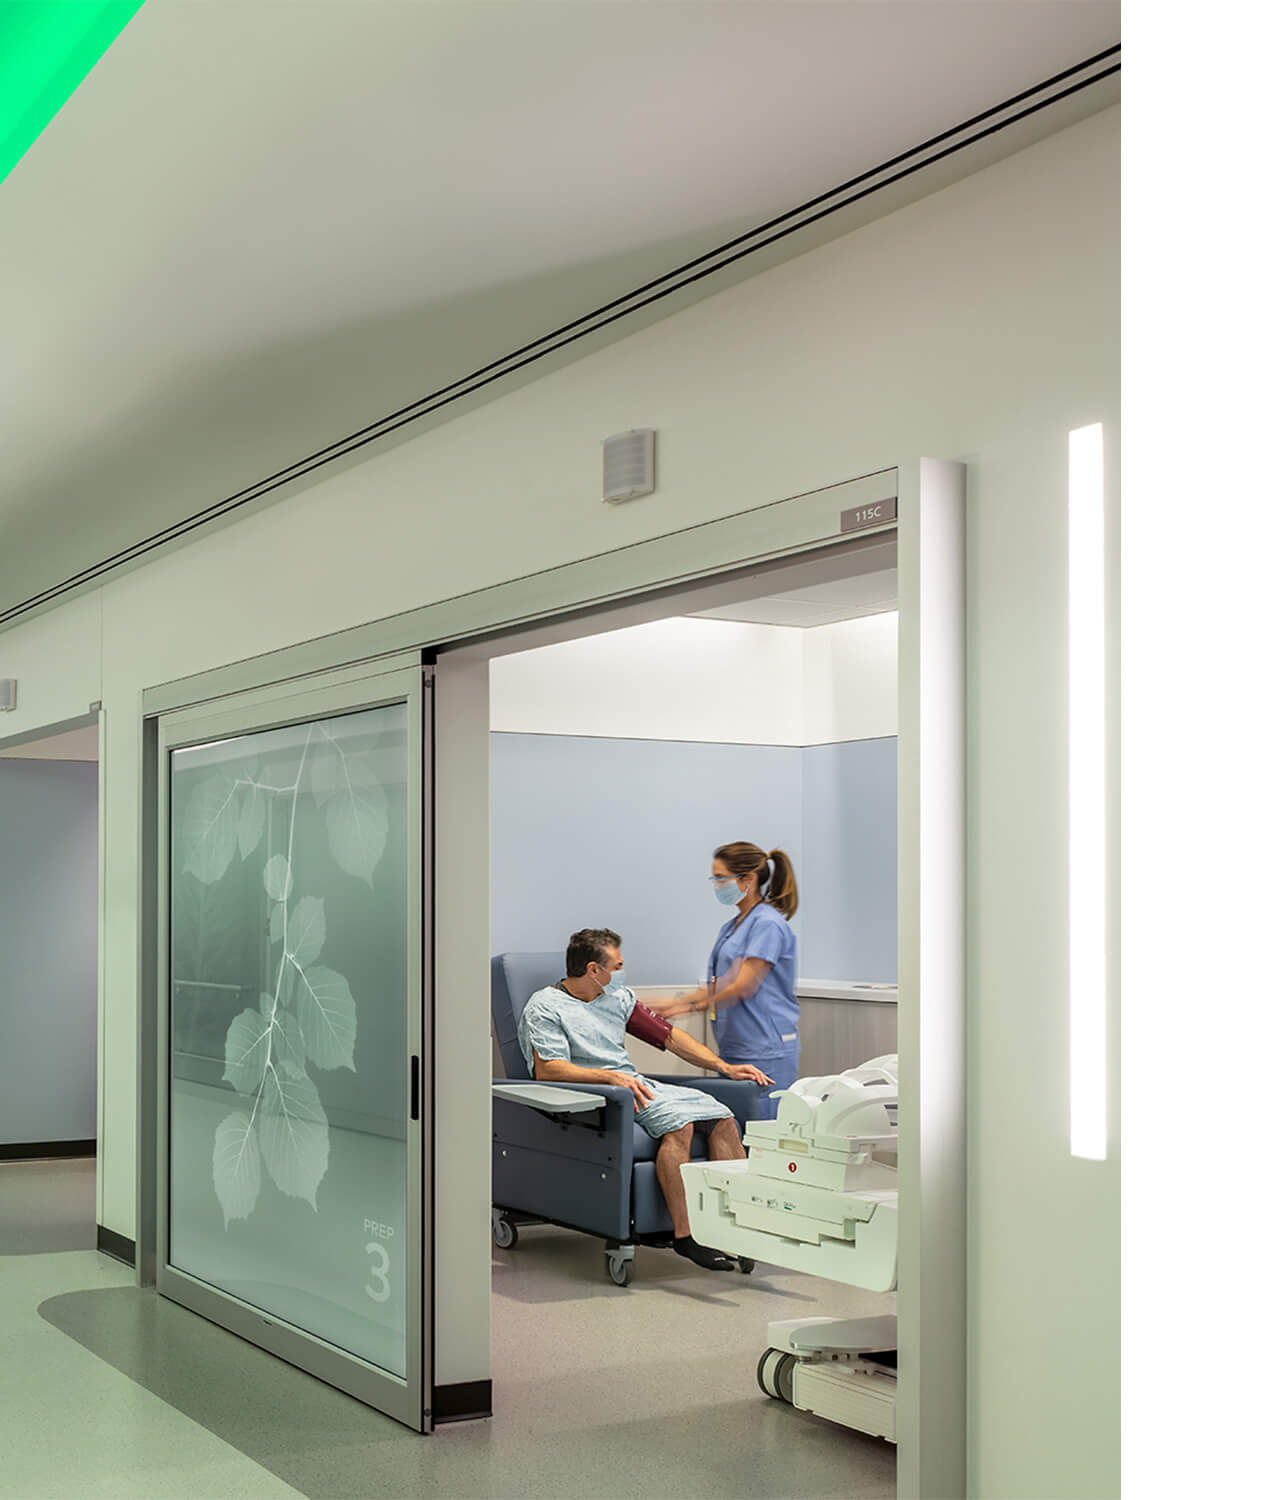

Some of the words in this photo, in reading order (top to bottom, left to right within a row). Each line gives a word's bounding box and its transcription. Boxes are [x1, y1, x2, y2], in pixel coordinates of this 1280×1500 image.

[855, 506, 881, 522] 115C
[363, 1218, 394, 1240] PREP
[365, 1242, 391, 1302] 3
